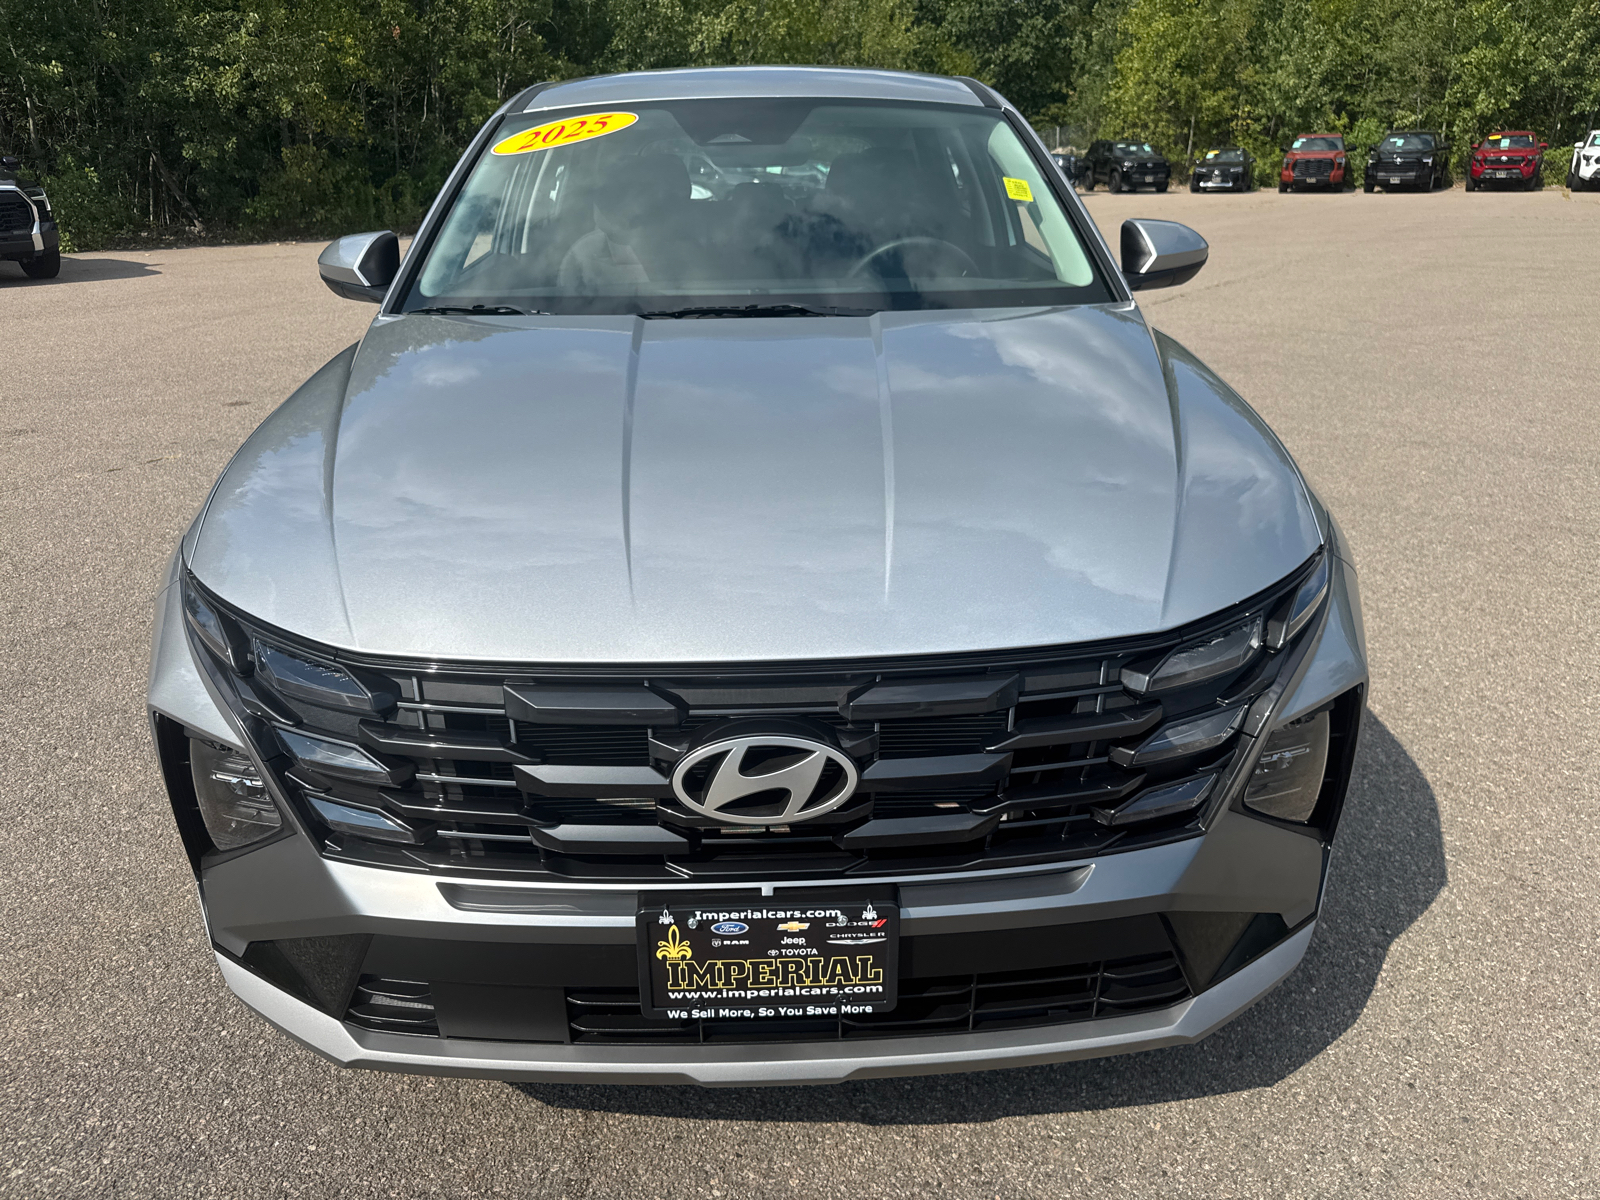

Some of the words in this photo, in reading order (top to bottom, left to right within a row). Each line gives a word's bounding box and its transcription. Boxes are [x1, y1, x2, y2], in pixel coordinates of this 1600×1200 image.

[516, 115, 613, 151] 2025
[694, 909, 841, 921] Imperialcars.com
[719, 924, 740, 932] Ford
[780, 936, 806, 945] Jeep
[781, 948, 818, 956] TOYOTA
[666, 955, 883, 990] IMPERIAL
[668, 985, 883, 999] www.imperialcars.com
[667, 1009, 688, 1019] We
[691, 1008, 715, 1019] Sell
[719, 1008, 755, 1018] More,
[758, 1007, 775, 1017] So
[778, 1006, 803, 1016] You
[806, 1005, 837, 1015] Save
[841, 1004, 873, 1014] More
